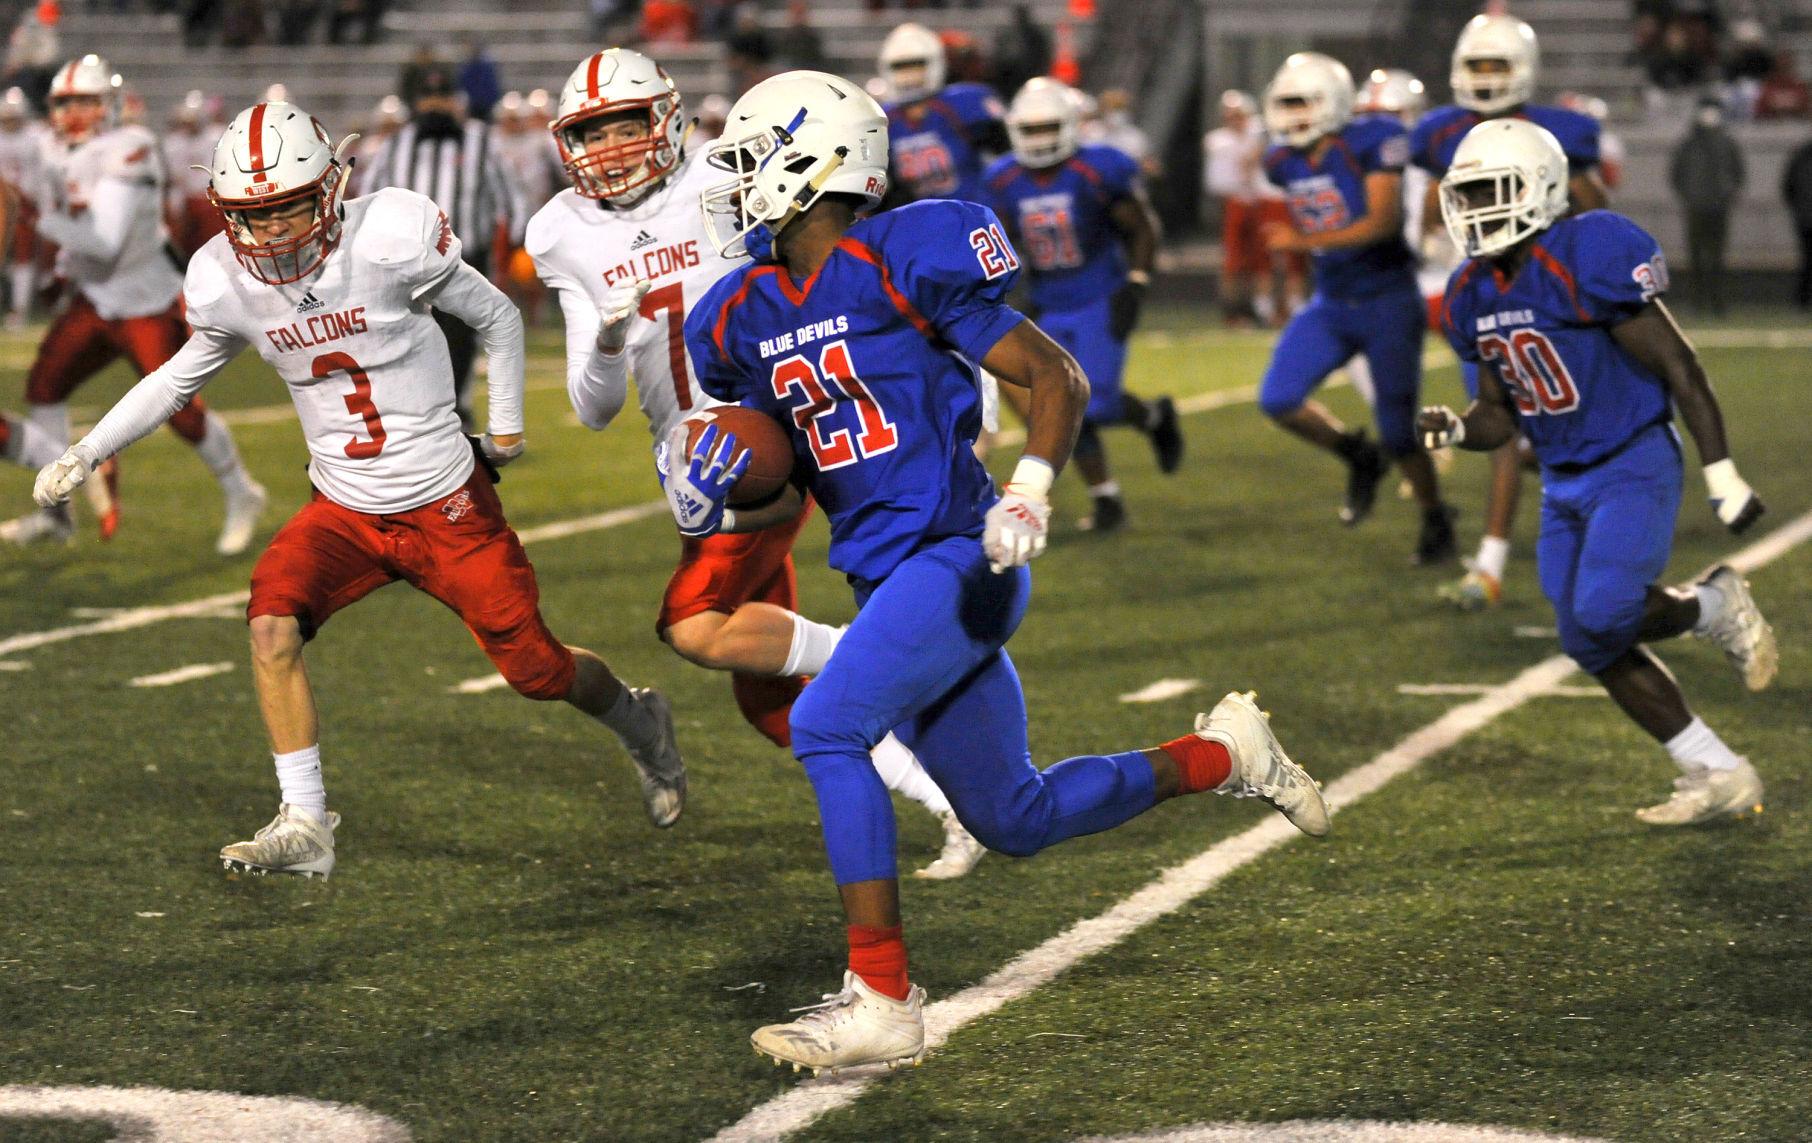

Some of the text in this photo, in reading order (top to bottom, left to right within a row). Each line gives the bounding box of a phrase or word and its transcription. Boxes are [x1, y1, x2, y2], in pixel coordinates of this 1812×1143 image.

[969, 223, 1019, 281] 21
[1021, 210, 1084, 271] 51
[265, 306, 368, 353] FALCONS
[297, 300, 325, 313] adidas
[760, 315, 849, 358] BLUE DEVILS
[637, 281, 693, 411] 7
[1477, 328, 1580, 416] 30
[311, 351, 387, 459] 3
[771, 339, 898, 472] 21
